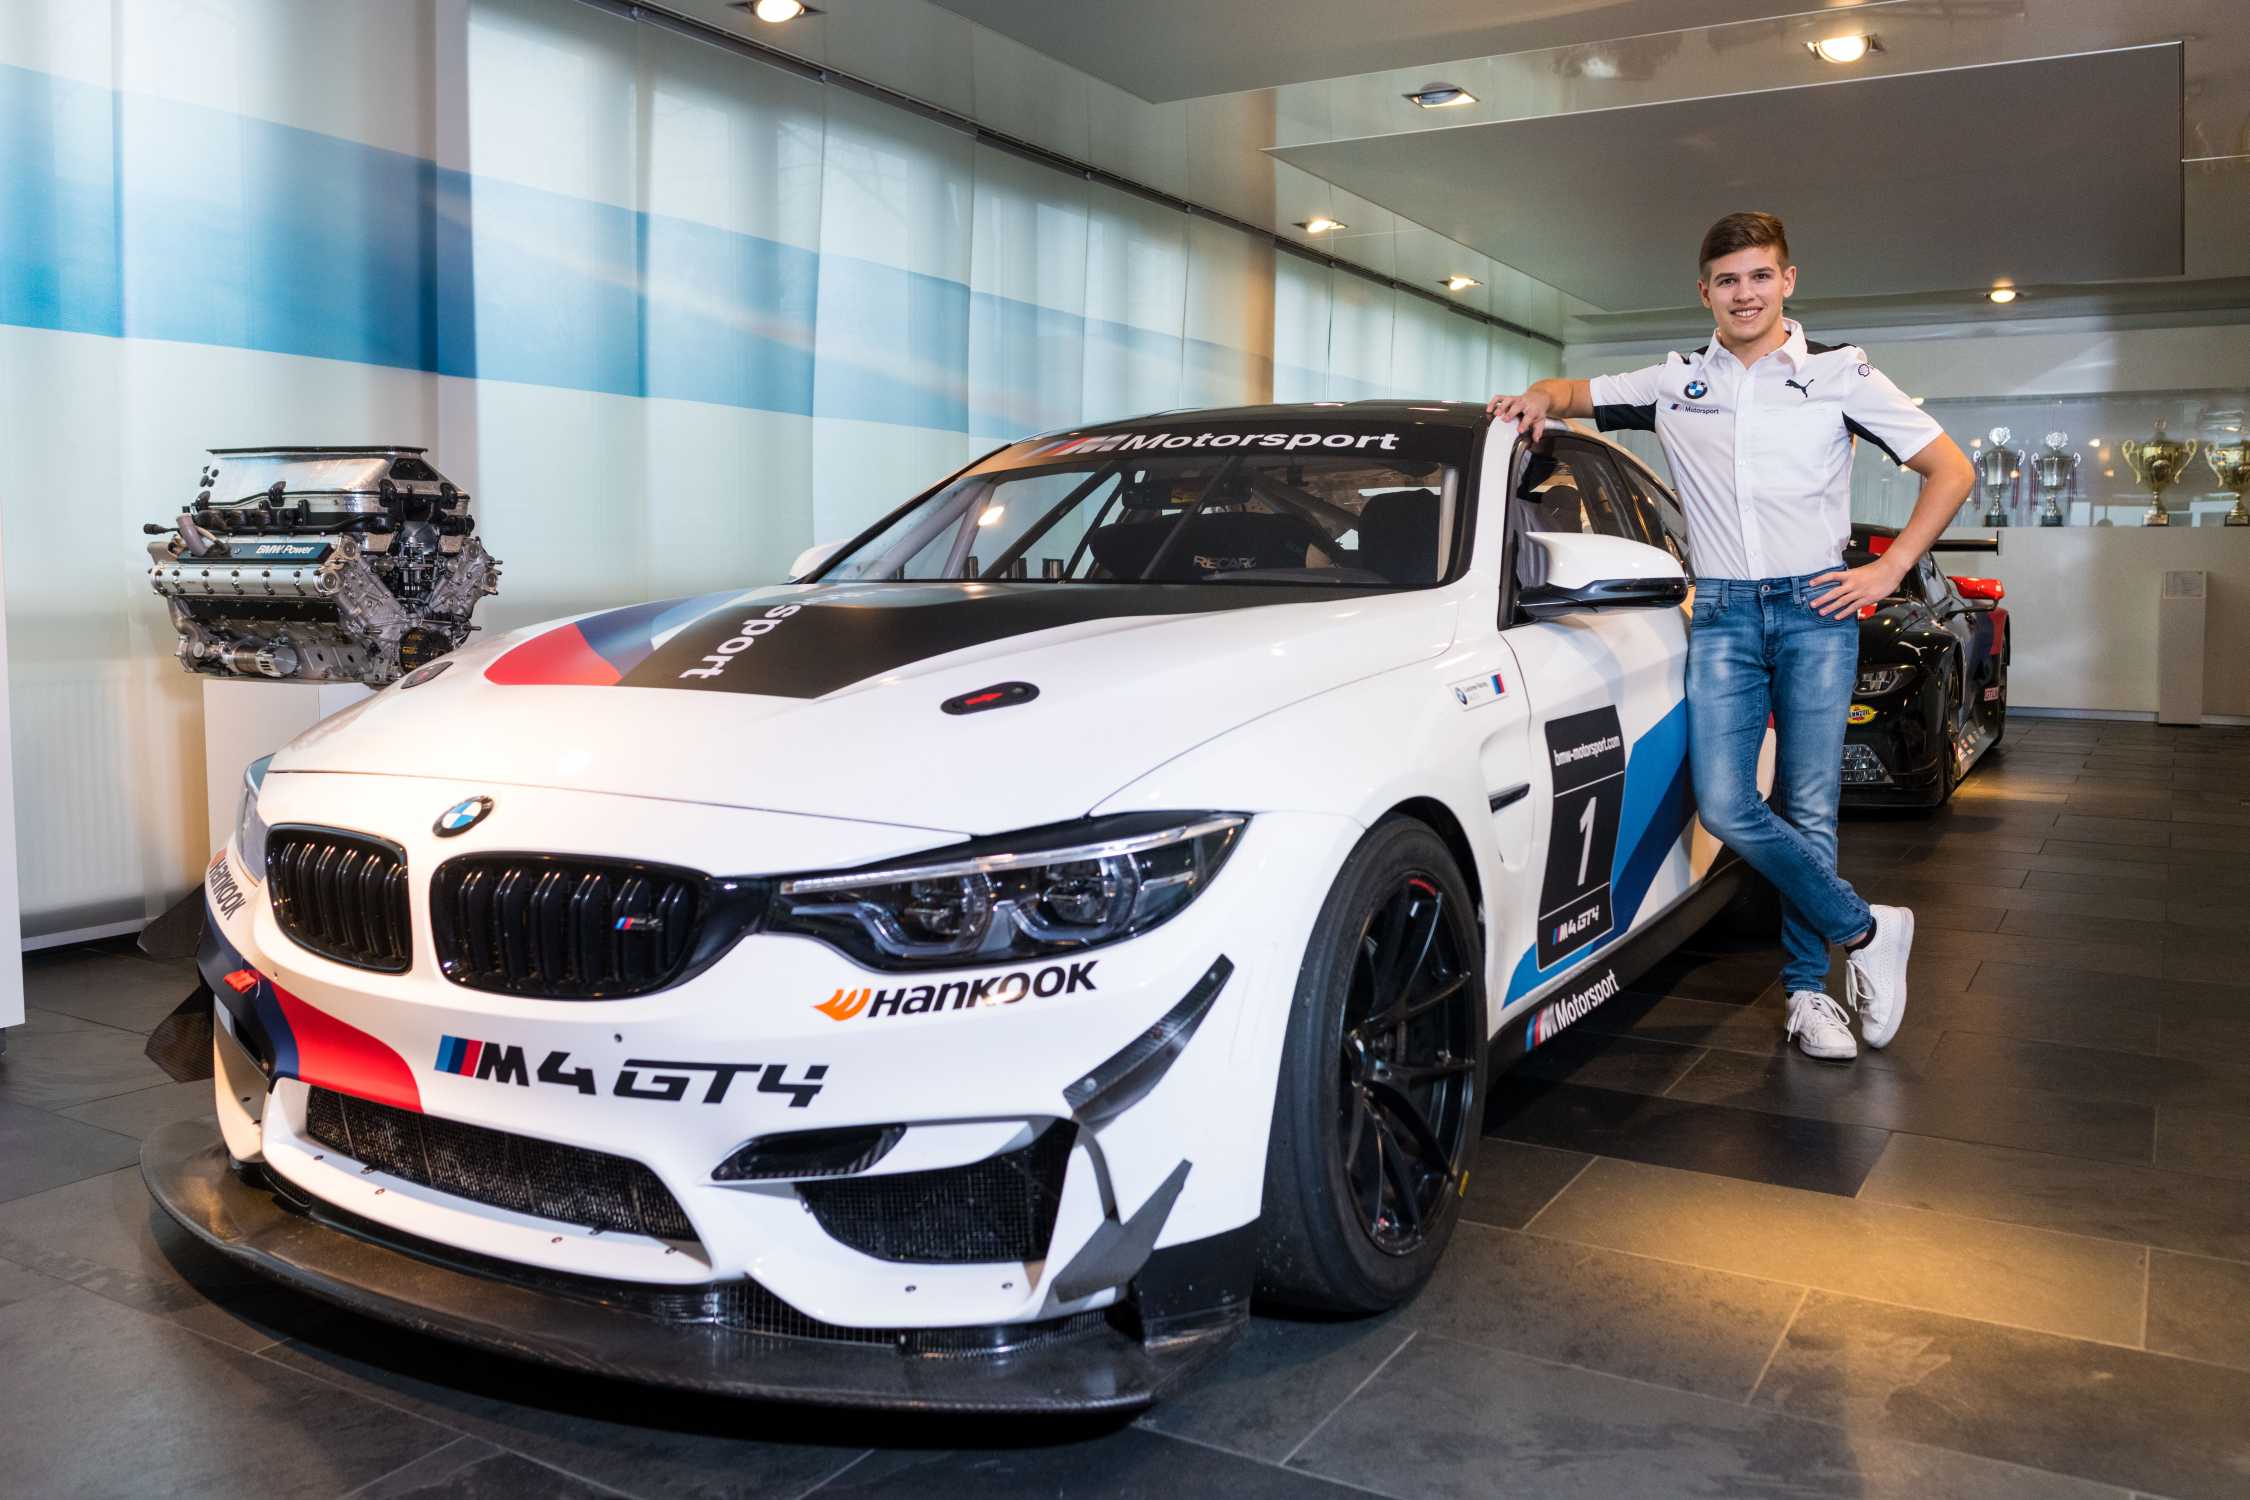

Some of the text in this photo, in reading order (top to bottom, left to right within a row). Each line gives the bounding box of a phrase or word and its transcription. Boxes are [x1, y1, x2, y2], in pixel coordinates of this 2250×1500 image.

[1684, 405, 1719, 414] Motorsport
[1118, 431, 1401, 451] Motorsport
[256, 544, 316, 554] BMW Power
[1553, 735, 1621, 767] bmw-motorsport.com
[1578, 796, 1598, 887] 1
[1577, 905, 1600, 931] GT4
[1554, 969, 1620, 1031] Motorsport
[612, 1058, 830, 1108] GT4
